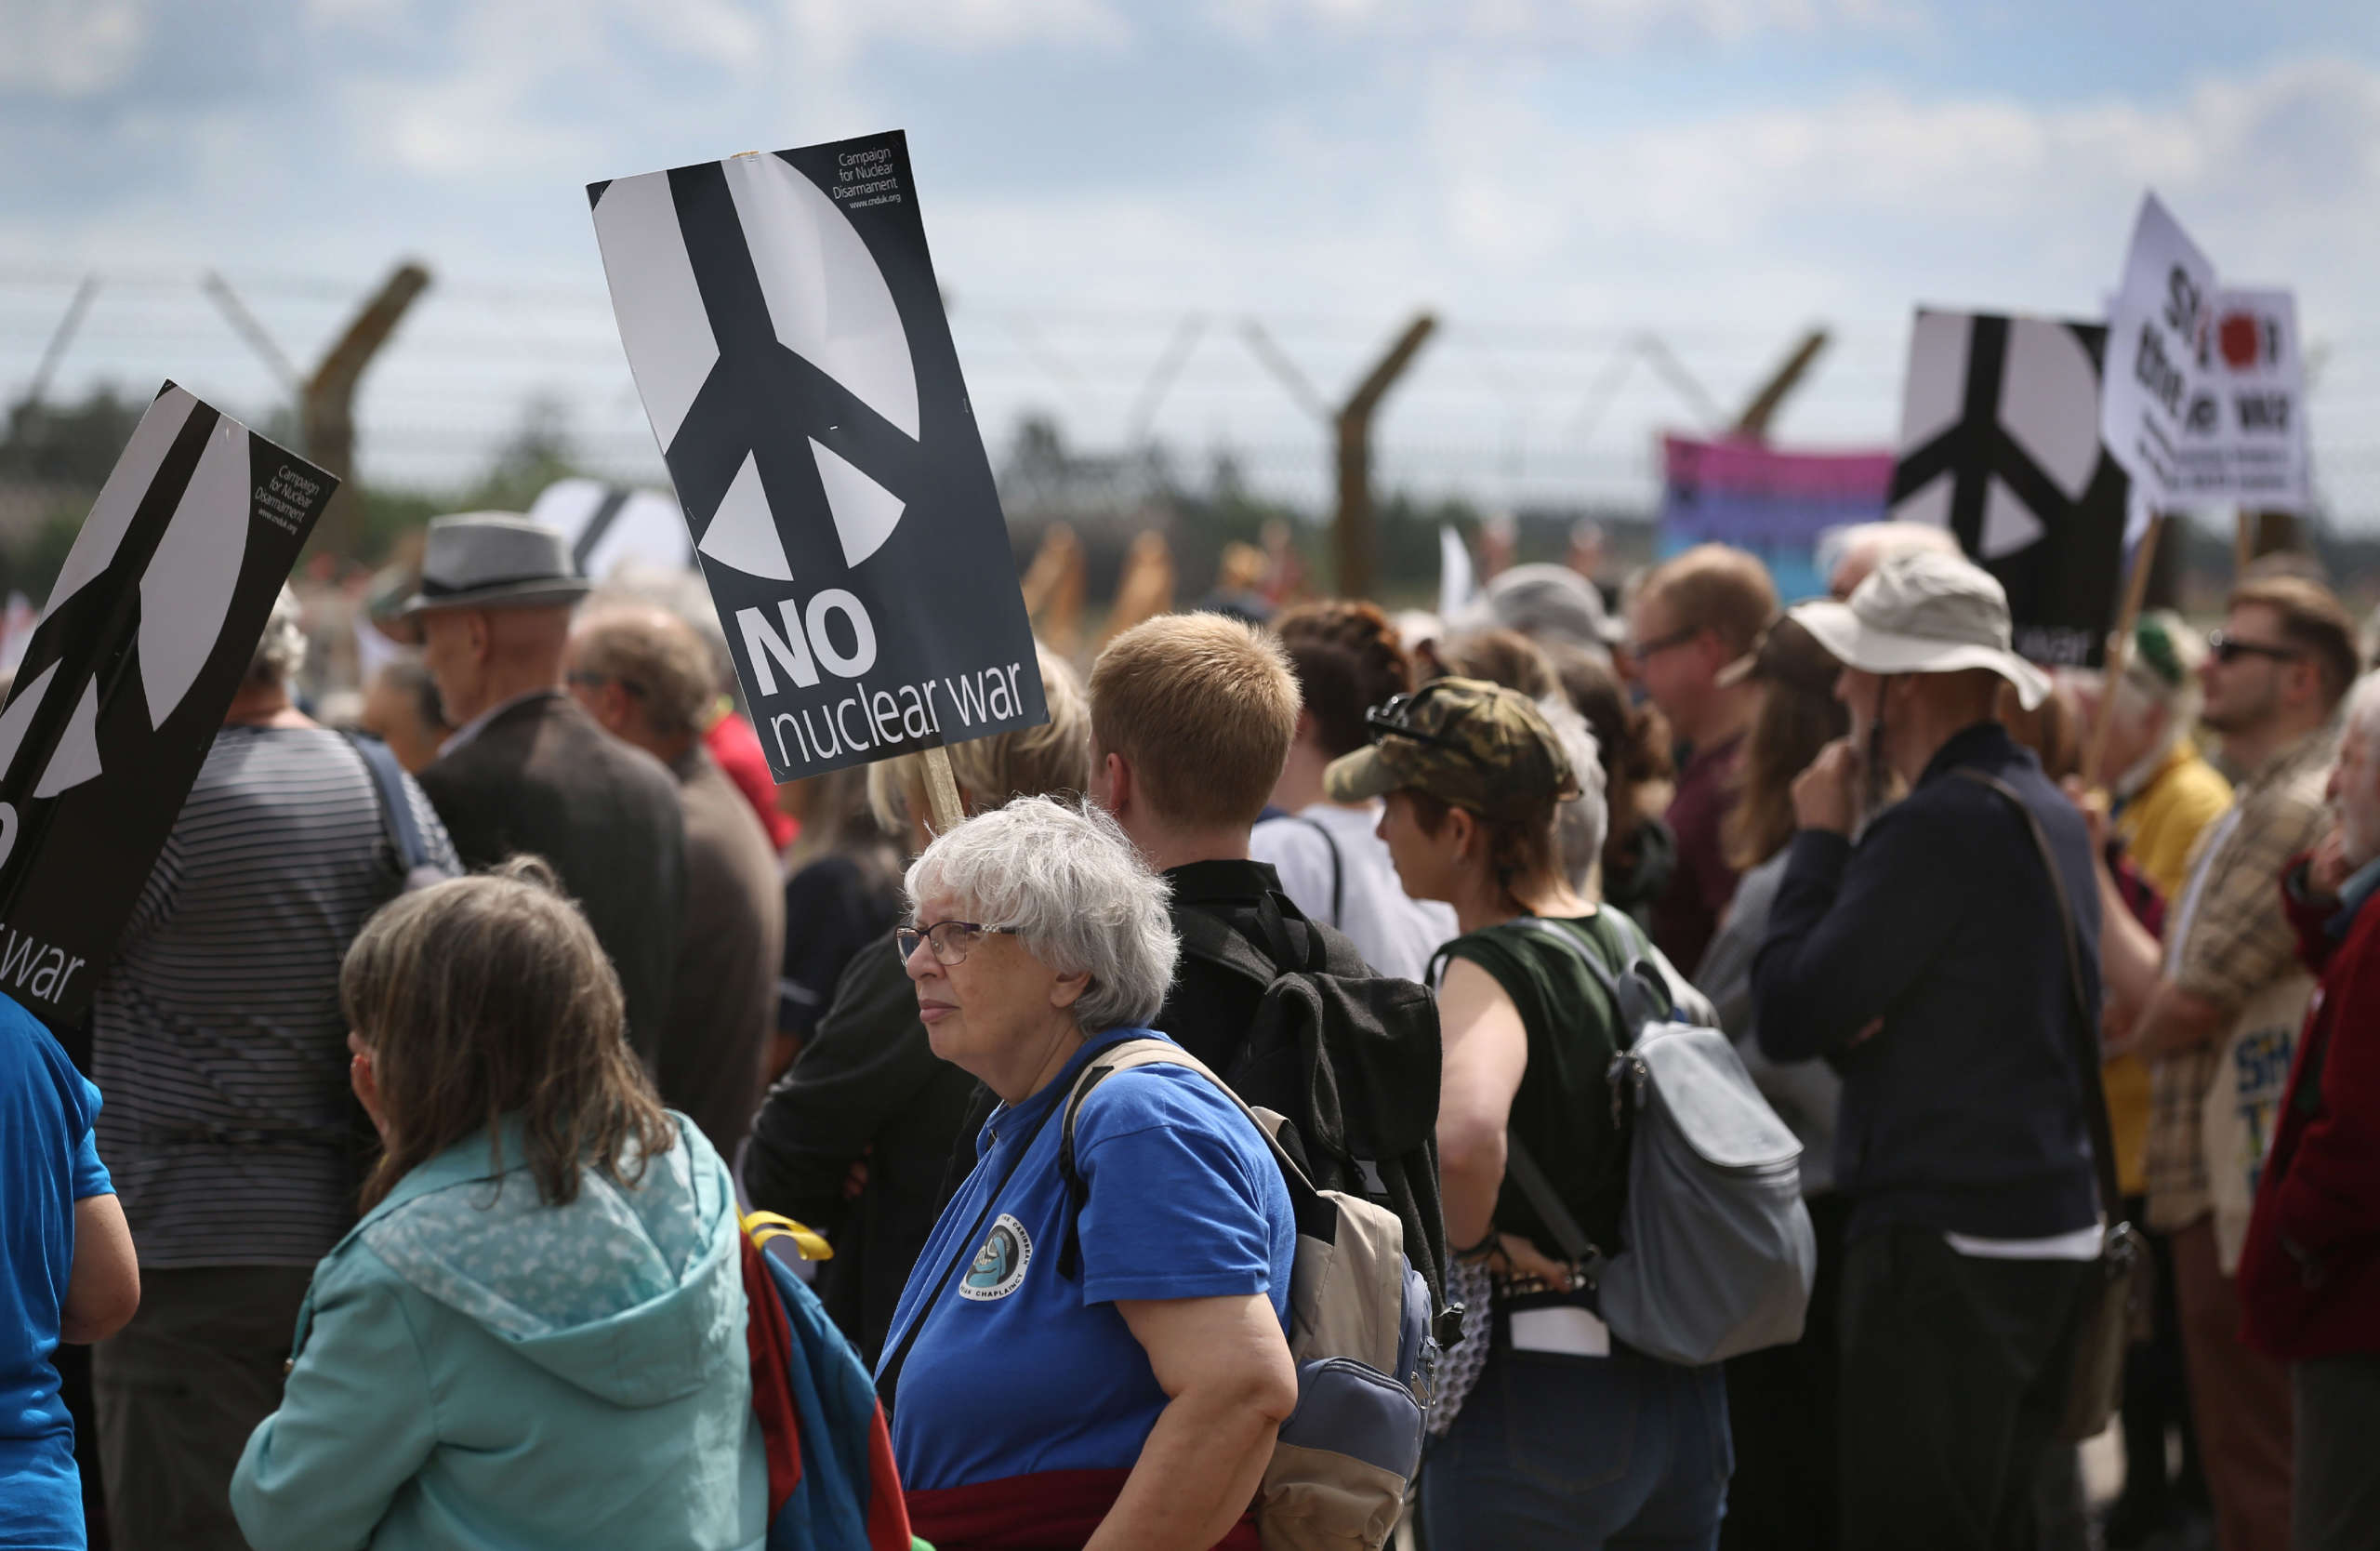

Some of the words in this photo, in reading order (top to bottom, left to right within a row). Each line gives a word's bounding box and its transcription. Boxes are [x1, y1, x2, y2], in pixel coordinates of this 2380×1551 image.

[839, 148, 892, 166] Campaign
[840, 168, 853, 182] for
[856, 163, 893, 179] Nuclear
[832, 178, 899, 200] Disarmament
[849, 193, 902, 209] www.cnduk.org
[269, 475, 283, 492] for
[281, 483, 313, 509] Nuclear
[278, 464, 321, 496] Campaign
[255, 484, 307, 524] Disarmament
[734, 589, 878, 697] NO
[770, 679, 942, 768] nuclear
[945, 662, 1024, 727] war
[0, 930, 86, 1004] war
[975, 1273, 1023, 1297] CHAPLAINCY
